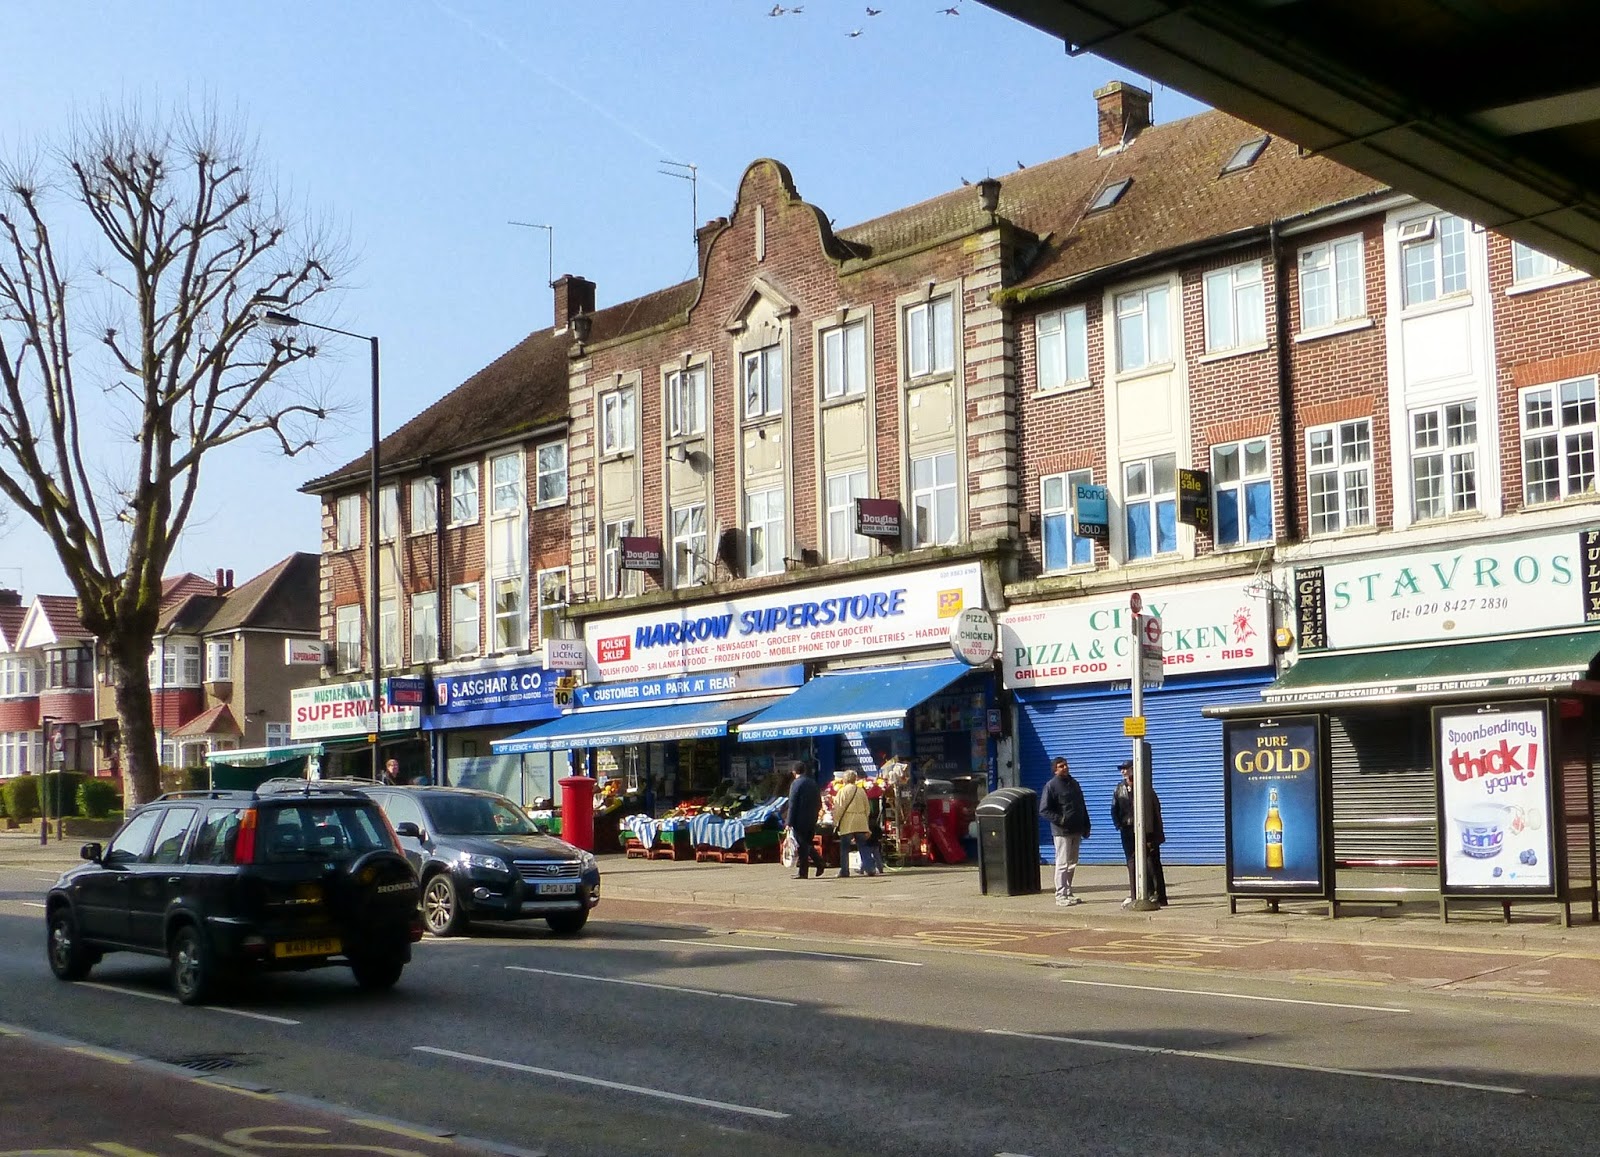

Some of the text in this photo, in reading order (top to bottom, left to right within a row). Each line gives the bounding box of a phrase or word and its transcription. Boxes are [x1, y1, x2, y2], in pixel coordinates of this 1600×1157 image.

[1181, 471, 1192, 480] for
[1181, 478, 1201, 490] sale
[1077, 486, 1105, 500] Bond
[863, 513, 898, 526] Douglas
[1080, 525, 1101, 534] SOLD
[626, 550, 659, 560] Douglas
[1334, 554, 1572, 610] STAVROS
[1299, 580, 1316, 648] GREEK
[1391, 597, 1508, 621] Tel: 020 8427 2830
[634, 588, 906, 649] HARROW SUPERSTORE
[966, 614, 988, 624] PIZZA
[601, 638, 626, 650] POLSKI
[668, 625, 874, 658] OFF LICENCE NEWSAGENT GROCERY GREEN GROCERY
[960, 631, 993, 641] CHICKEN
[552, 651, 583, 659] LICENCE
[560, 643, 574, 651] OFF
[603, 650, 624, 660] SKLEP
[621, 665, 639, 674] FOOD
[647, 662, 658, 671] SRI
[658, 659, 687, 670] LANKAN
[687, 656, 706, 666] FOOD
[714, 653, 740, 663] FROZEN
[741, 650, 761, 660] FOOD
[769, 644, 797, 656] MOBILE
[798, 641, 824, 653] PHONE
[826, 640, 840, 650] TOP
[842, 639, 852, 648] UP
[862, 632, 905, 645] TOILETRIES
[1014, 642, 1080, 667] PIZZA
[1088, 639, 1105, 660] &
[293, 652, 321, 661] SUPERMARKET
[1015, 666, 1067, 680] GRILLED
[1073, 662, 1108, 674] FOOD
[1222, 648, 1254, 660] RIBS
[452, 677, 507, 698] S.ASGHAR
[511, 676, 518, 691] &
[521, 673, 541, 689] CO
[594, 677, 736, 700] CUSTOMER CAR PARK AT REAR
[313, 687, 346, 703] MUSTAFA
[762, 729, 778, 738] FOOD
[782, 726, 803, 736] MOBILE
[805, 725, 817, 734] TOP
[819, 724, 828, 733] UP
[832, 722, 862, 732] PAYPOINT
[865, 718, 900, 729] HARDWARE
[1448, 719, 1537, 746] Spoonbendingly
[589, 737, 613, 746] GROCERY
[618, 734, 639, 743] FROZEN
[641, 733, 658, 741] FOOD
[664, 731, 675, 739] SRI
[676, 729, 698, 738] LANKAN
[701, 728, 718, 736] FOOD
[1257, 735, 1288, 747] PURE
[1234, 749, 1311, 773] GOLD
[1485, 772, 1527, 794] yogurt
[1462, 825, 1503, 847] danio
[377, 881, 419, 893] HONDA
